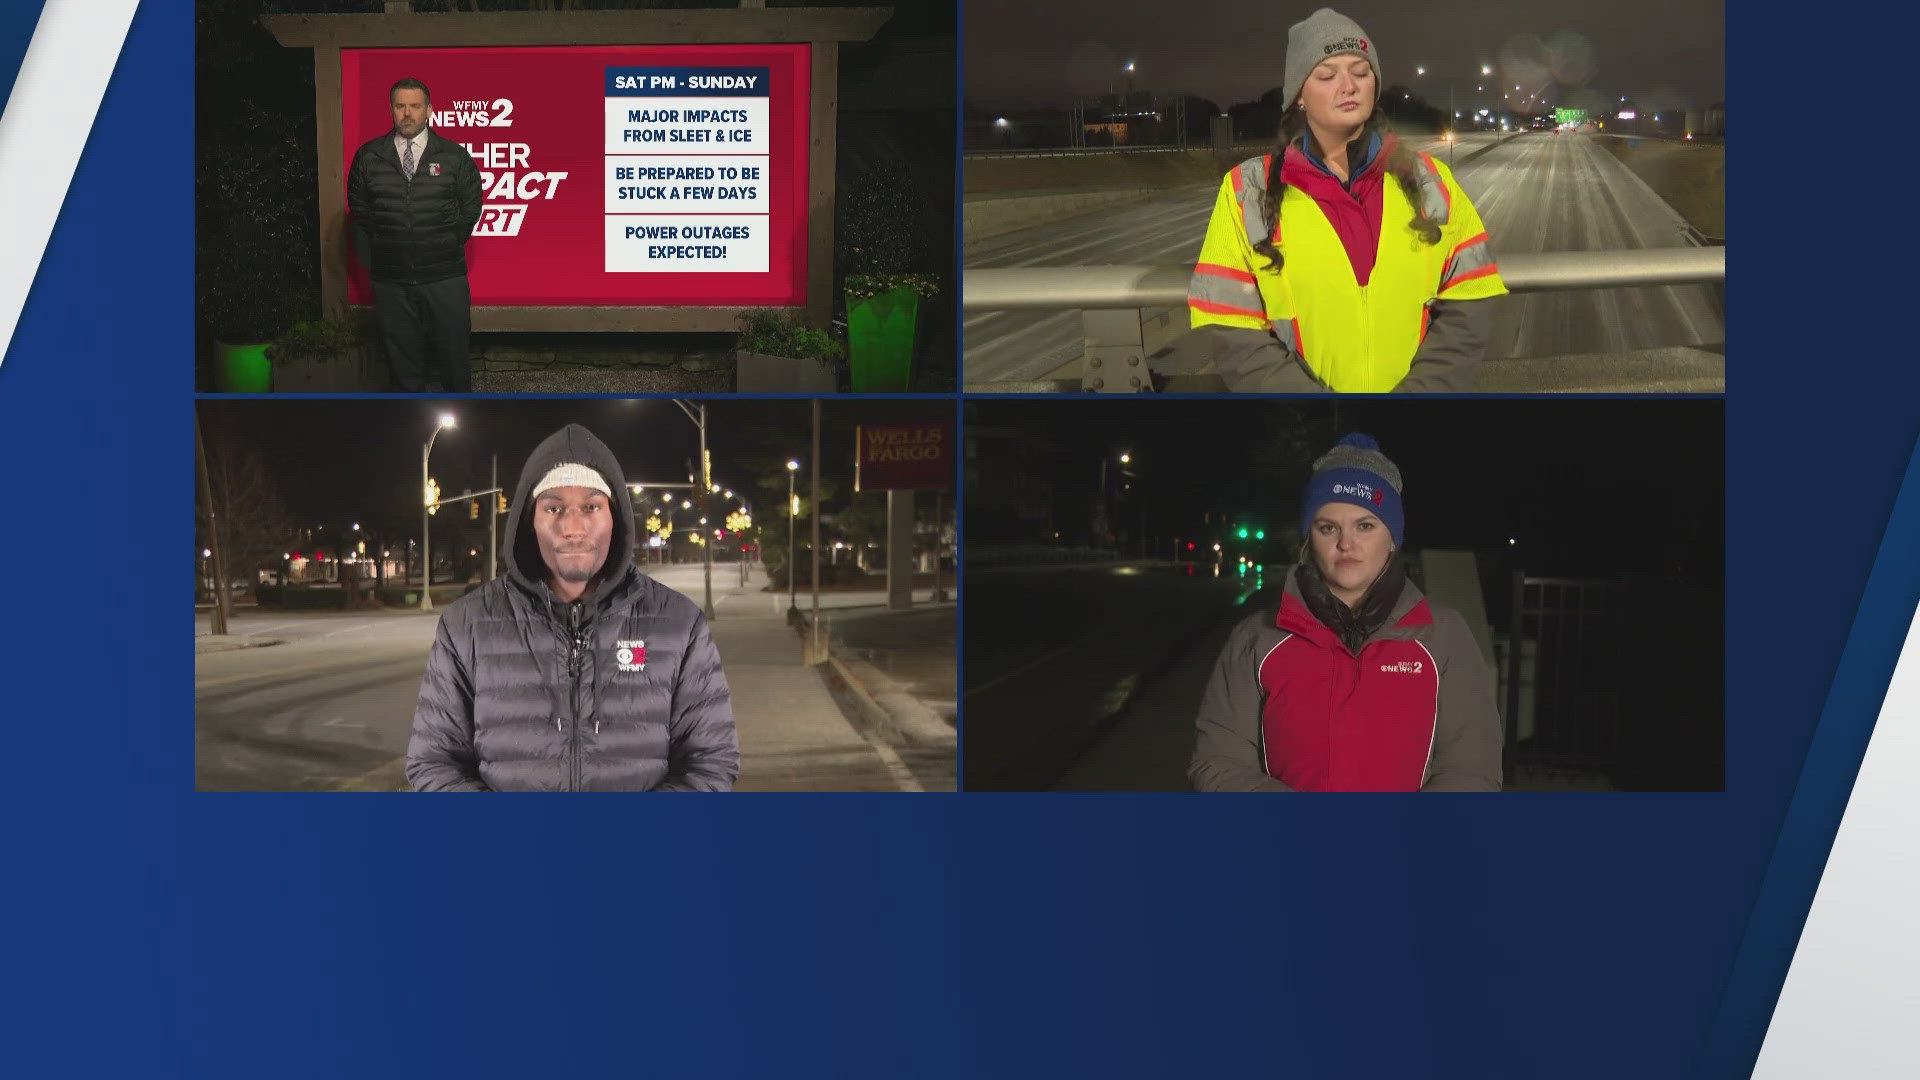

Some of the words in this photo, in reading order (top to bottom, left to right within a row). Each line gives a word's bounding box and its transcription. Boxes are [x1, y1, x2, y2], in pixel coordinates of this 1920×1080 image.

[615, 76, 646, 89] SAT
[650, 76, 676, 89] PM
[689, 76, 757, 89] SUNDAY
[453, 101, 490, 110] WFMY
[628, 110, 679, 122] MAJOR
[683, 110, 748, 122] IMPACTS
[624, 130, 666, 142] FROM
[670, 130, 711, 142] SLEET
[716, 130, 725, 142] &
[729, 130, 752, 142] ICE
[616, 167, 634, 180] BE
[638, 167, 714, 180] PREPARED
[718, 167, 738, 180] TO
[741, 167, 760, 180] BE
[618, 187, 666, 199] STUCK
[670, 187, 680, 199] A
[683, 187, 714, 199] FEW
[718, 187, 757, 199] DAYS
[625, 227, 678, 239] POWER
[681, 227, 750, 239] OUTAGES
[648, 246, 727, 258] EXPECTED!
[868, 428, 942, 444] WELLS
[868, 444, 941, 461] FARGO
[617, 640, 645, 648] NEWS
[618, 664, 645, 672] WFMY
